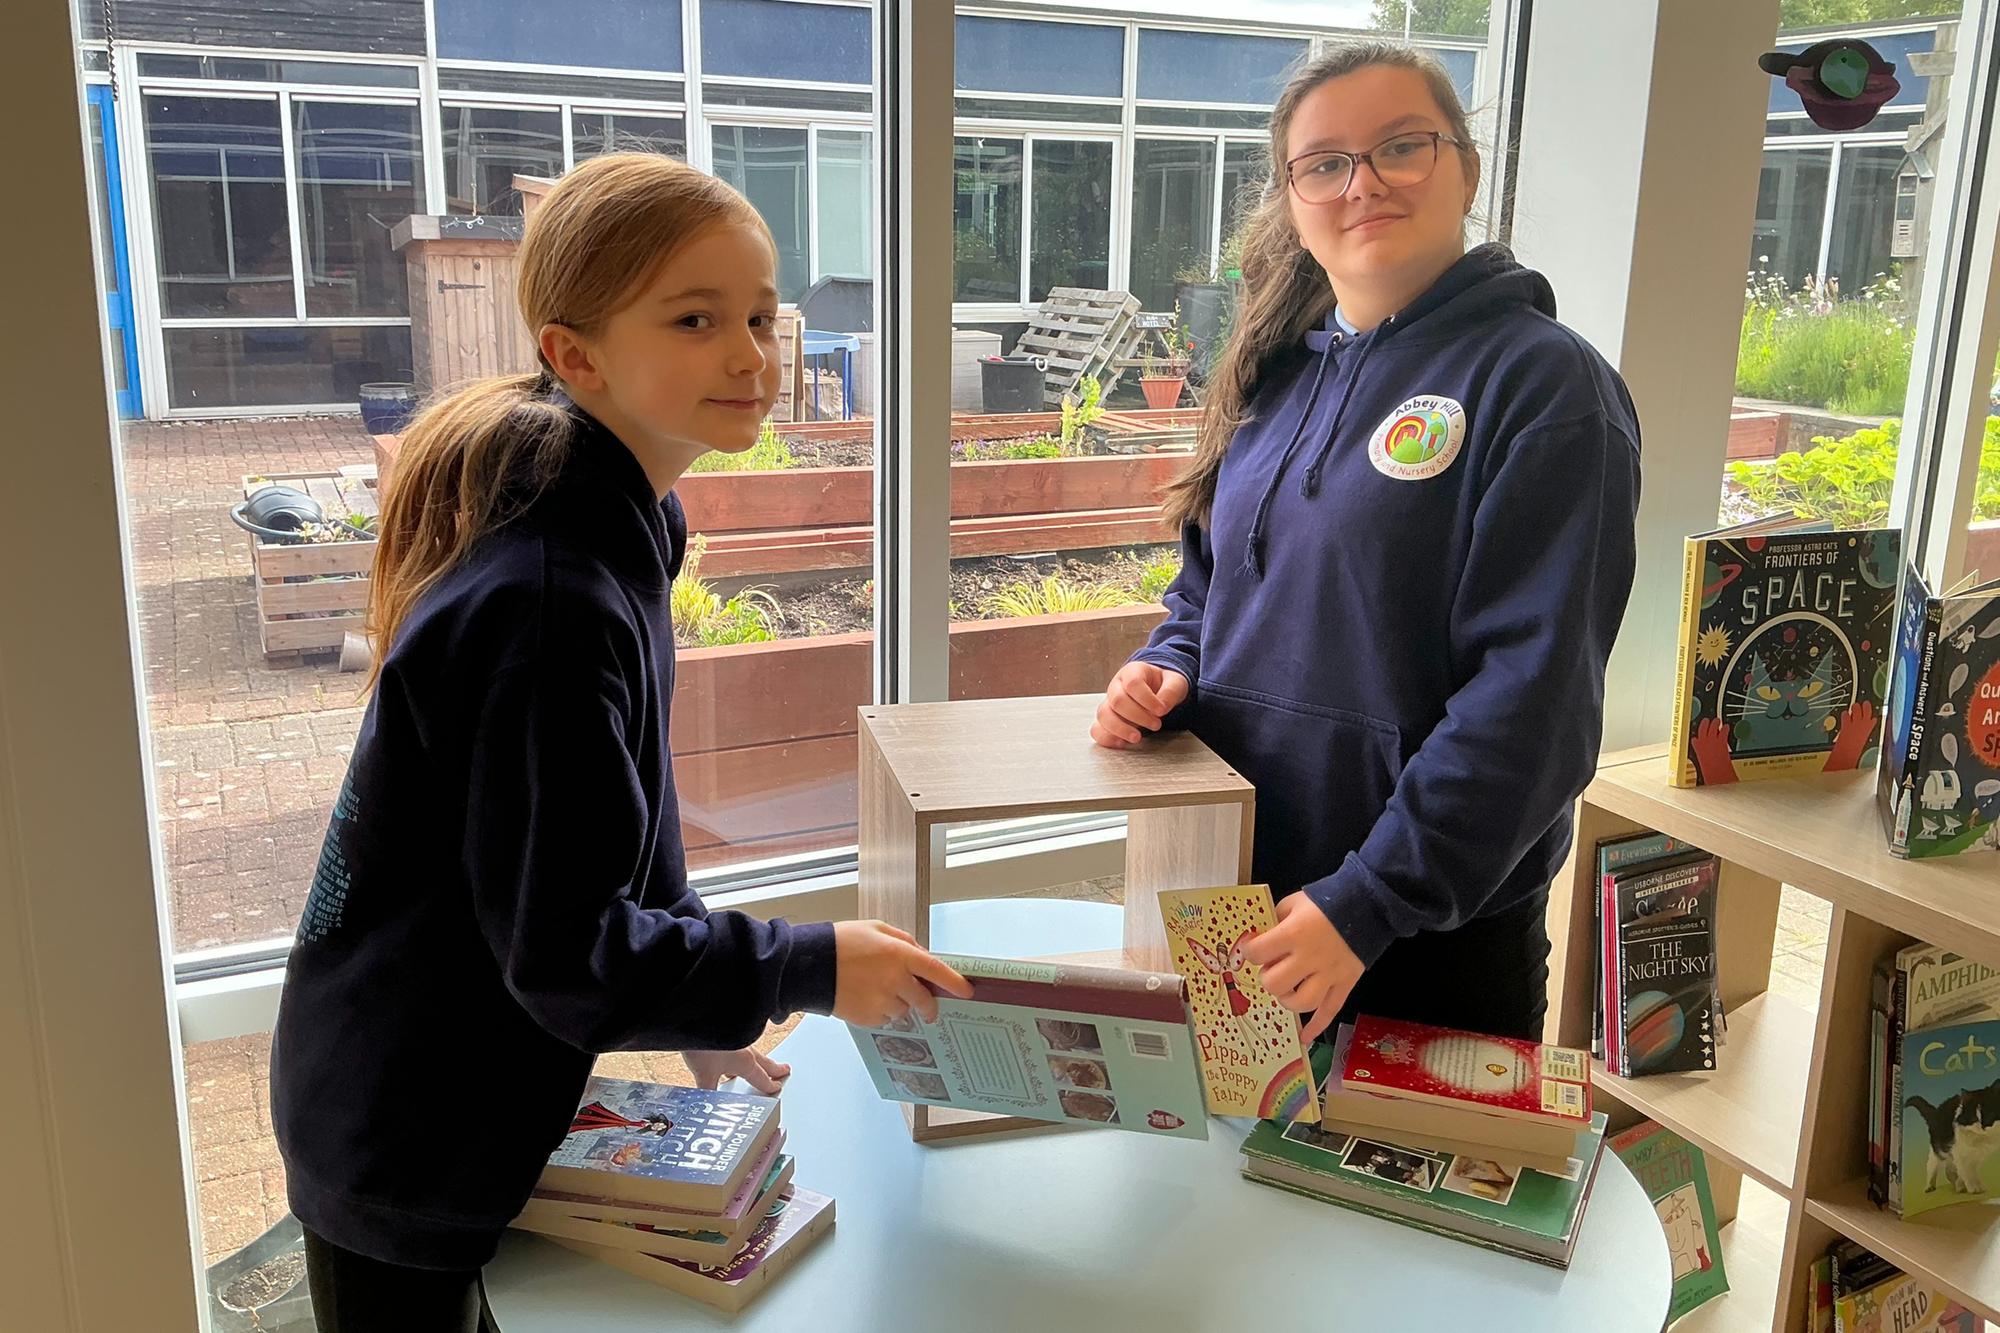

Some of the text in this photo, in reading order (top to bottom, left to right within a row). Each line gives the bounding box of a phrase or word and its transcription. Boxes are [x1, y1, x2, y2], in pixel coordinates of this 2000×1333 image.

[1395, 399, 1462, 418] Abbey Hill
[1398, 465, 1436, 476] Nursery
[1437, 439, 1459, 466] School
[1765, 551, 1840, 569] FRONTIERS OF
[1769, 541, 1838, 554] PROFESSOR ASTRO CAT'S
[1740, 567, 1858, 625] SPACE
[1923, 631, 1937, 673] Questions
[1915, 681, 1929, 719] Answers
[1908, 723, 1924, 761] Space
[1634, 866, 1701, 890] USBORNE DISCOVERY
[1167, 904, 1203, 932] RAINBOW
[1649, 941, 1683, 960] THE
[972, 959, 999, 975] Best
[1002, 962, 1050, 981] Recipes
[1629, 956, 1710, 982] NIGHT SKY
[1197, 1033, 1249, 1067] Pippa
[1920, 1034, 1998, 1076] Cats
[1205, 1069, 1220, 1081] the
[1219, 1066, 1259, 1092] Poppy
[1212, 1086, 1248, 1107] Fairy
[677, 1102, 751, 1170] WITCH
[711, 1132, 748, 1172] POUNDER
[713, 1253, 756, 1279] Russell
[1893, 1290, 1928, 1333] HEAD
